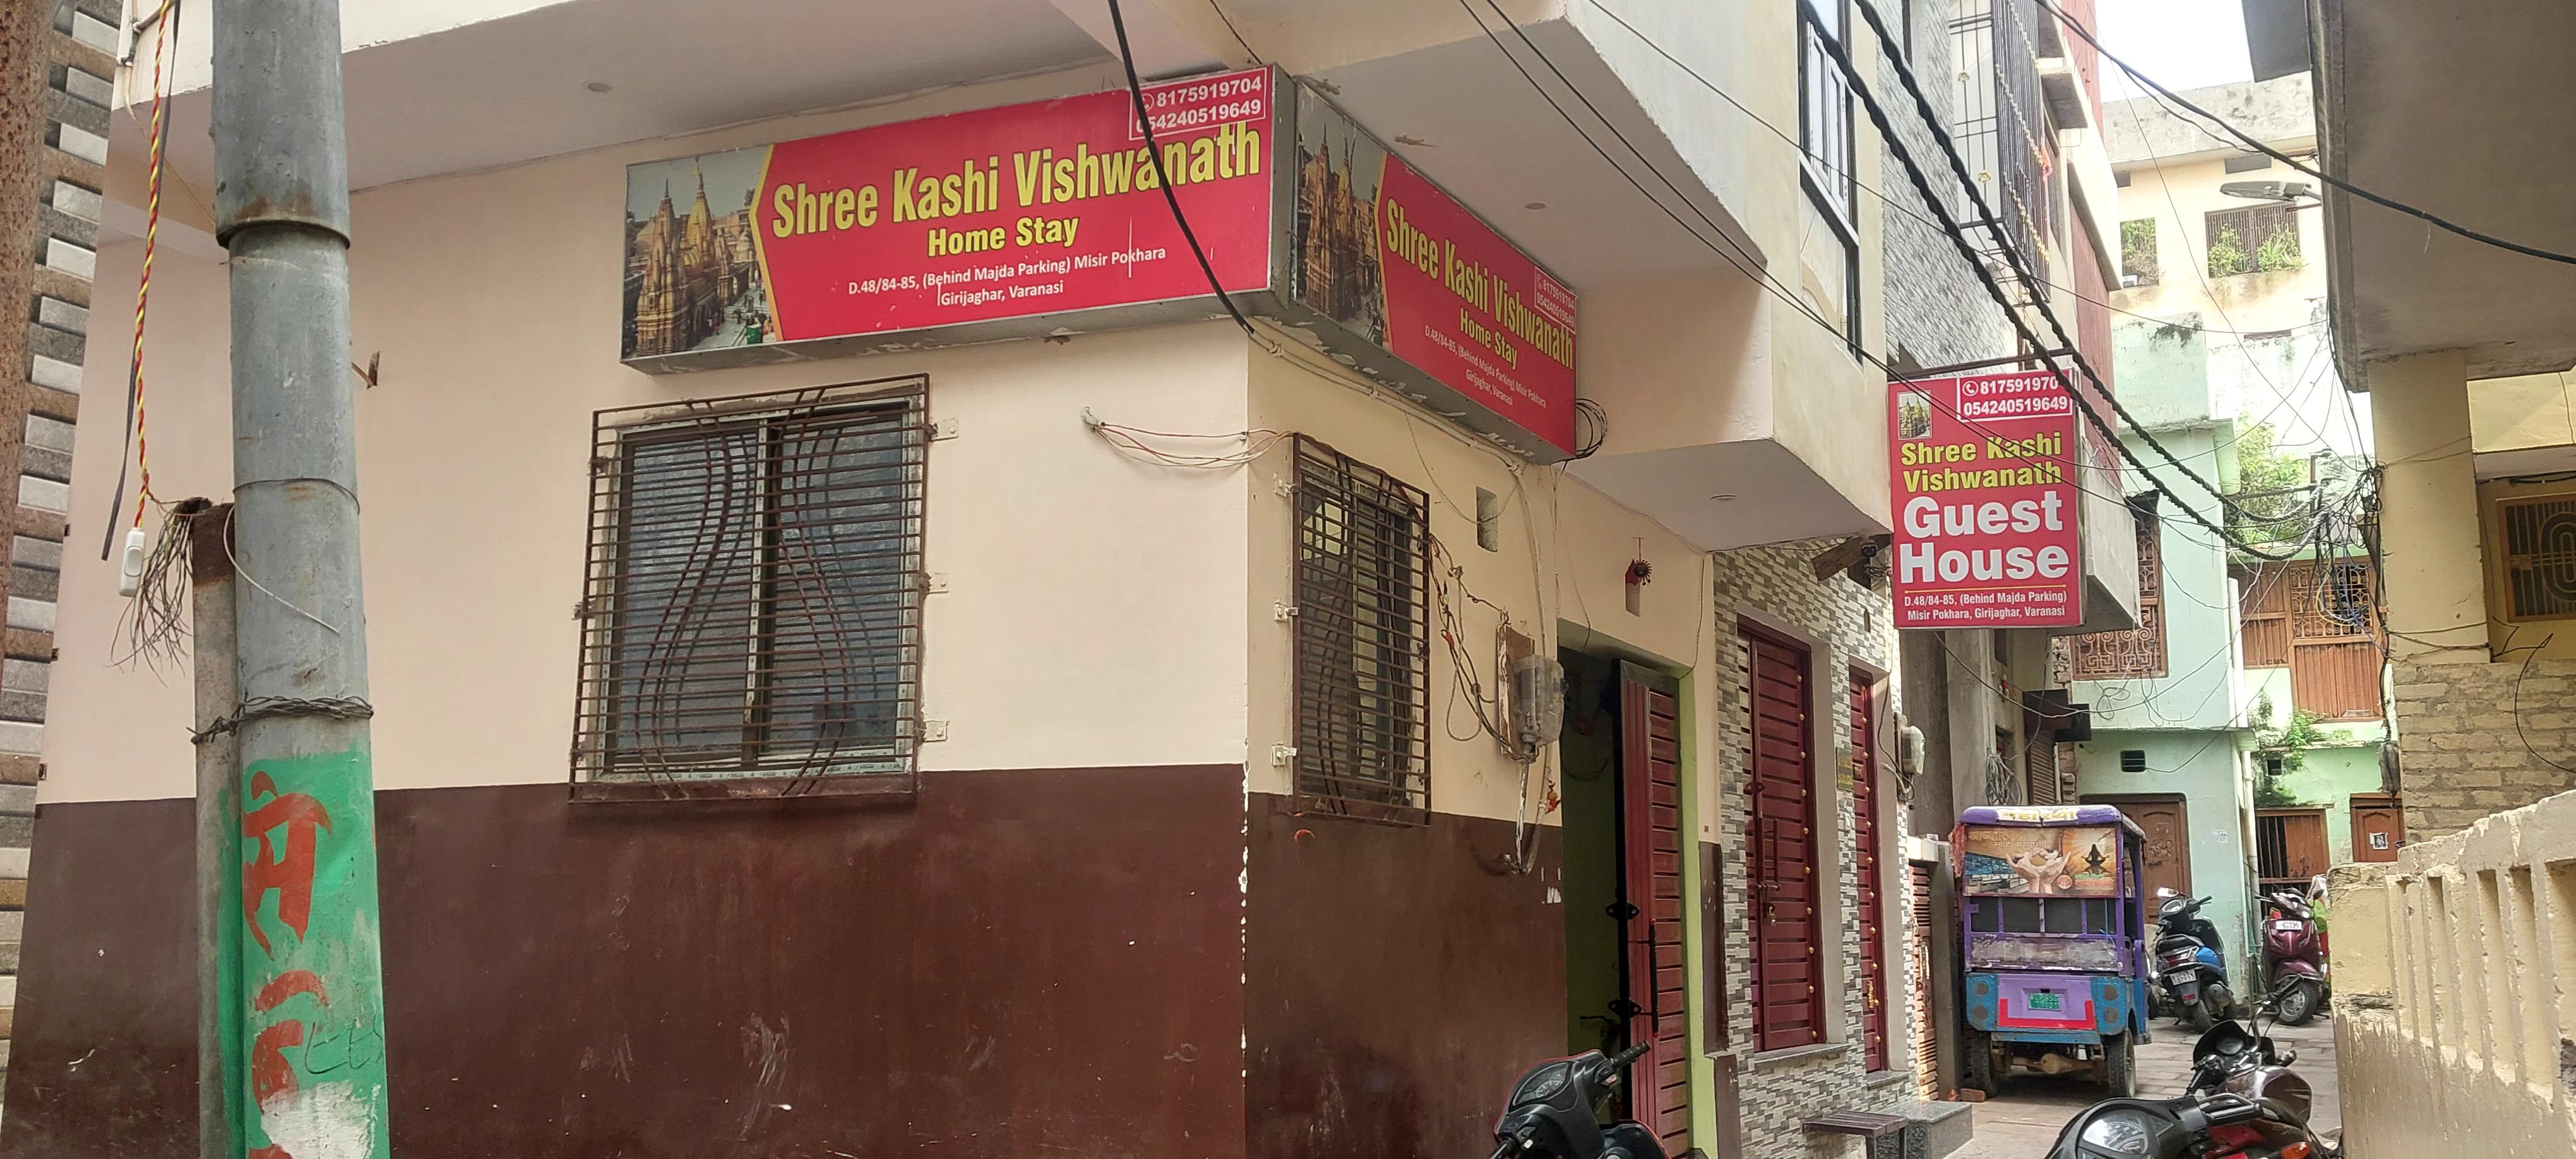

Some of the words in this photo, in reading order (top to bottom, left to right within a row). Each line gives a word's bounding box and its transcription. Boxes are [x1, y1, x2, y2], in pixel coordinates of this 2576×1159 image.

[1156, 76, 1261, 107] 8175919704
[772, 182, 878, 239] Shree
[892, 155, 1000, 223] Kashi
[1013, 120, 1261, 208] Vishwanath
[926, 226, 1006, 258] Home
[1015, 216, 1080, 247] Stay
[847, 275, 920, 295] D.48/84-85,
[922, 268, 972, 290] (Behind
[975, 263, 1015, 282] Majda
[1018, 256, 1071, 275] Parking)
[1074, 253, 1108, 270] Misir
[1111, 247, 1166, 265] Pokhara
[1386, 198, 1440, 280] Shree
[1445, 237, 1489, 314] Kashi
[1493, 273, 1574, 371] Vishwanath
[941, 288, 1006, 307] Girijaghar,
[1008, 280, 1064, 299] Varanasi
[1460, 307, 1492, 350] Home
[1494, 330, 1518, 371] Stay
[1458, 344, 1479, 367] (Behind
[1479, 357, 1496, 377] Majda
[1495, 367, 1515, 392] Parking)
[1515, 380, 1527, 397] Misir
[1527, 388, 1546, 408] Pokhara
[1980, 375, 2060, 395] 817591970
[1492, 384, 1513, 406] Varanasi
[1964, 395, 2068, 416] 054240519649
[1900, 442, 1977, 466] Shree
[1986, 431, 2061, 460] Kashi
[1902, 461, 2063, 493] Vishwanath
[1904, 490, 2063, 538] Guest
[1900, 542, 2070, 584] House
[1904, 595, 1958, 607] D.48/84-85,
[1960, 593, 1995, 607] (Behind
[1997, 591, 2026, 605] Majda
[2029, 590, 2067, 603] Parking)
[1907, 610, 1930, 621] Misir
[1933, 609, 1972, 621] Pokhara,
[1974, 607, 2022, 620] Girijaghar,
[2024, 605, 2066, 617] Varanasi
